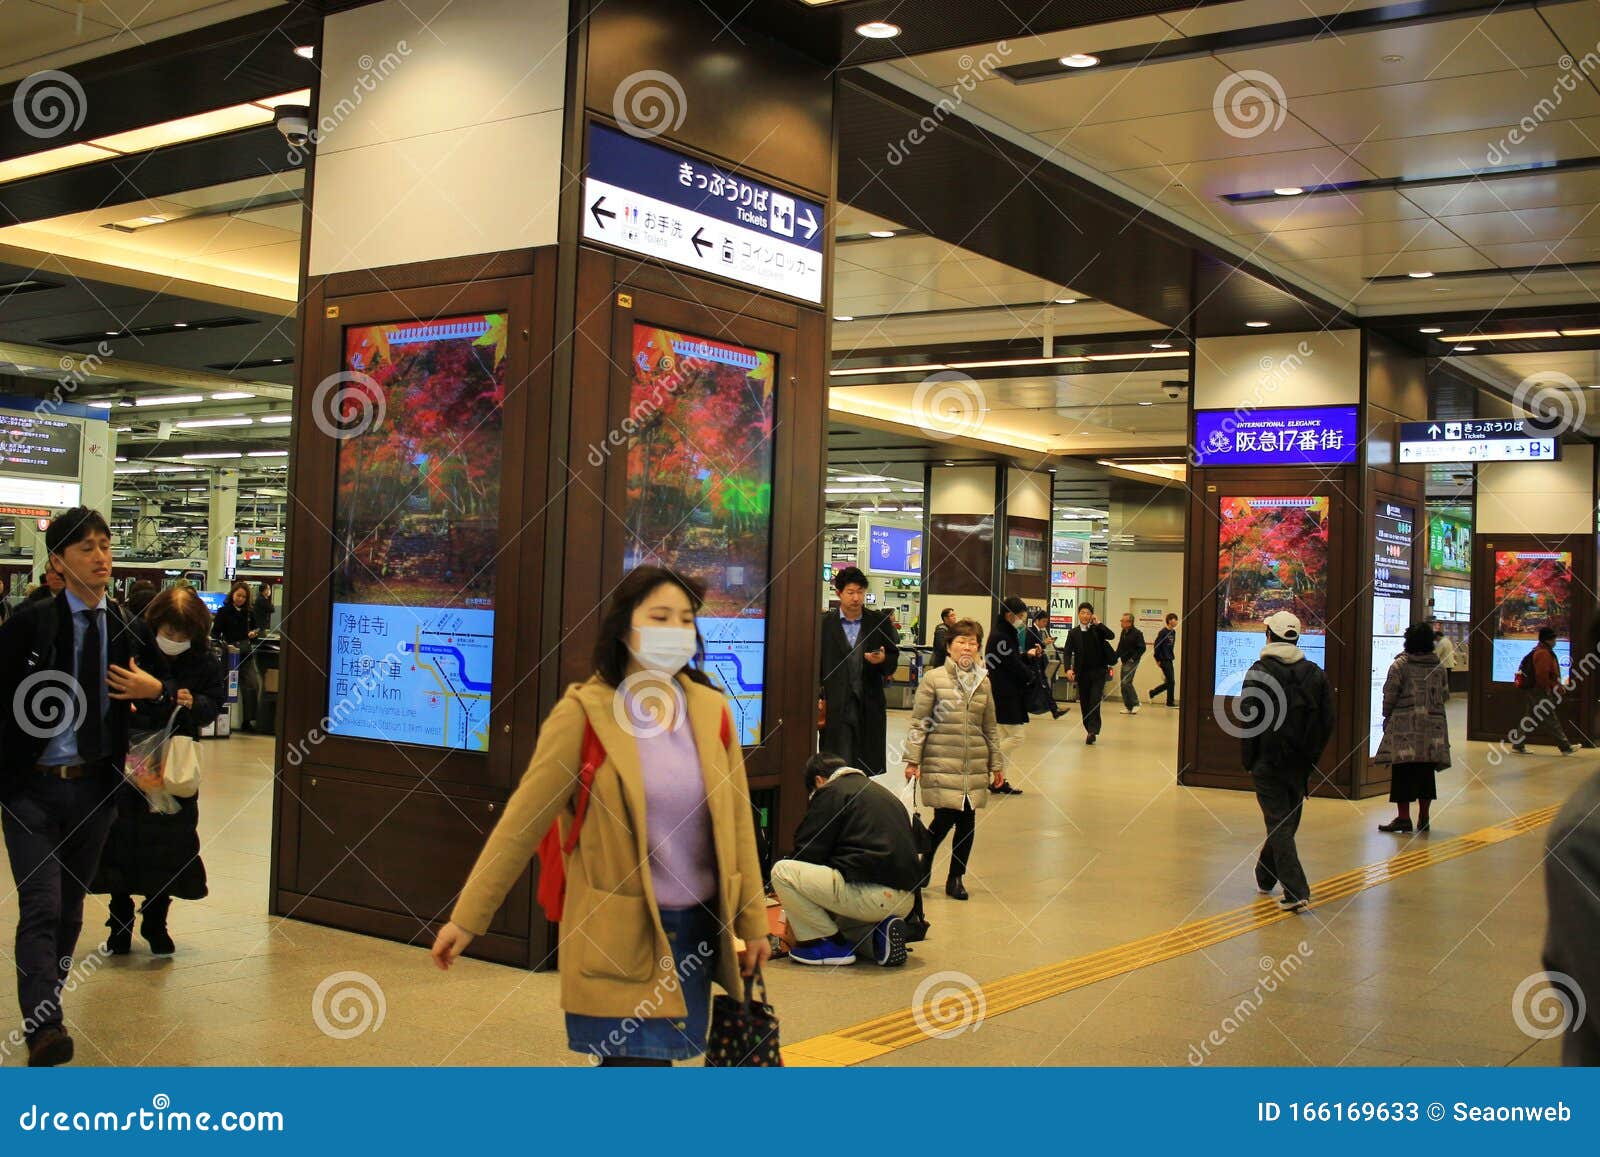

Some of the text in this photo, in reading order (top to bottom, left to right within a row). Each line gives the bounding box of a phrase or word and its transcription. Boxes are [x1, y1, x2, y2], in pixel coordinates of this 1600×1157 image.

[679, 162, 768, 213] きっぷうりば
[736, 207, 768, 229] Tickets
[742, 242, 816, 276] コインロッカー
[1236, 420, 1285, 429] INTERNATIONAL
[1464, 420, 1525, 433] きっぷうりば
[1235, 429, 1344, 452] 阪急17番街
[1052, 598, 1074, 609] ATM
[337, 635, 363, 655] 阪急
